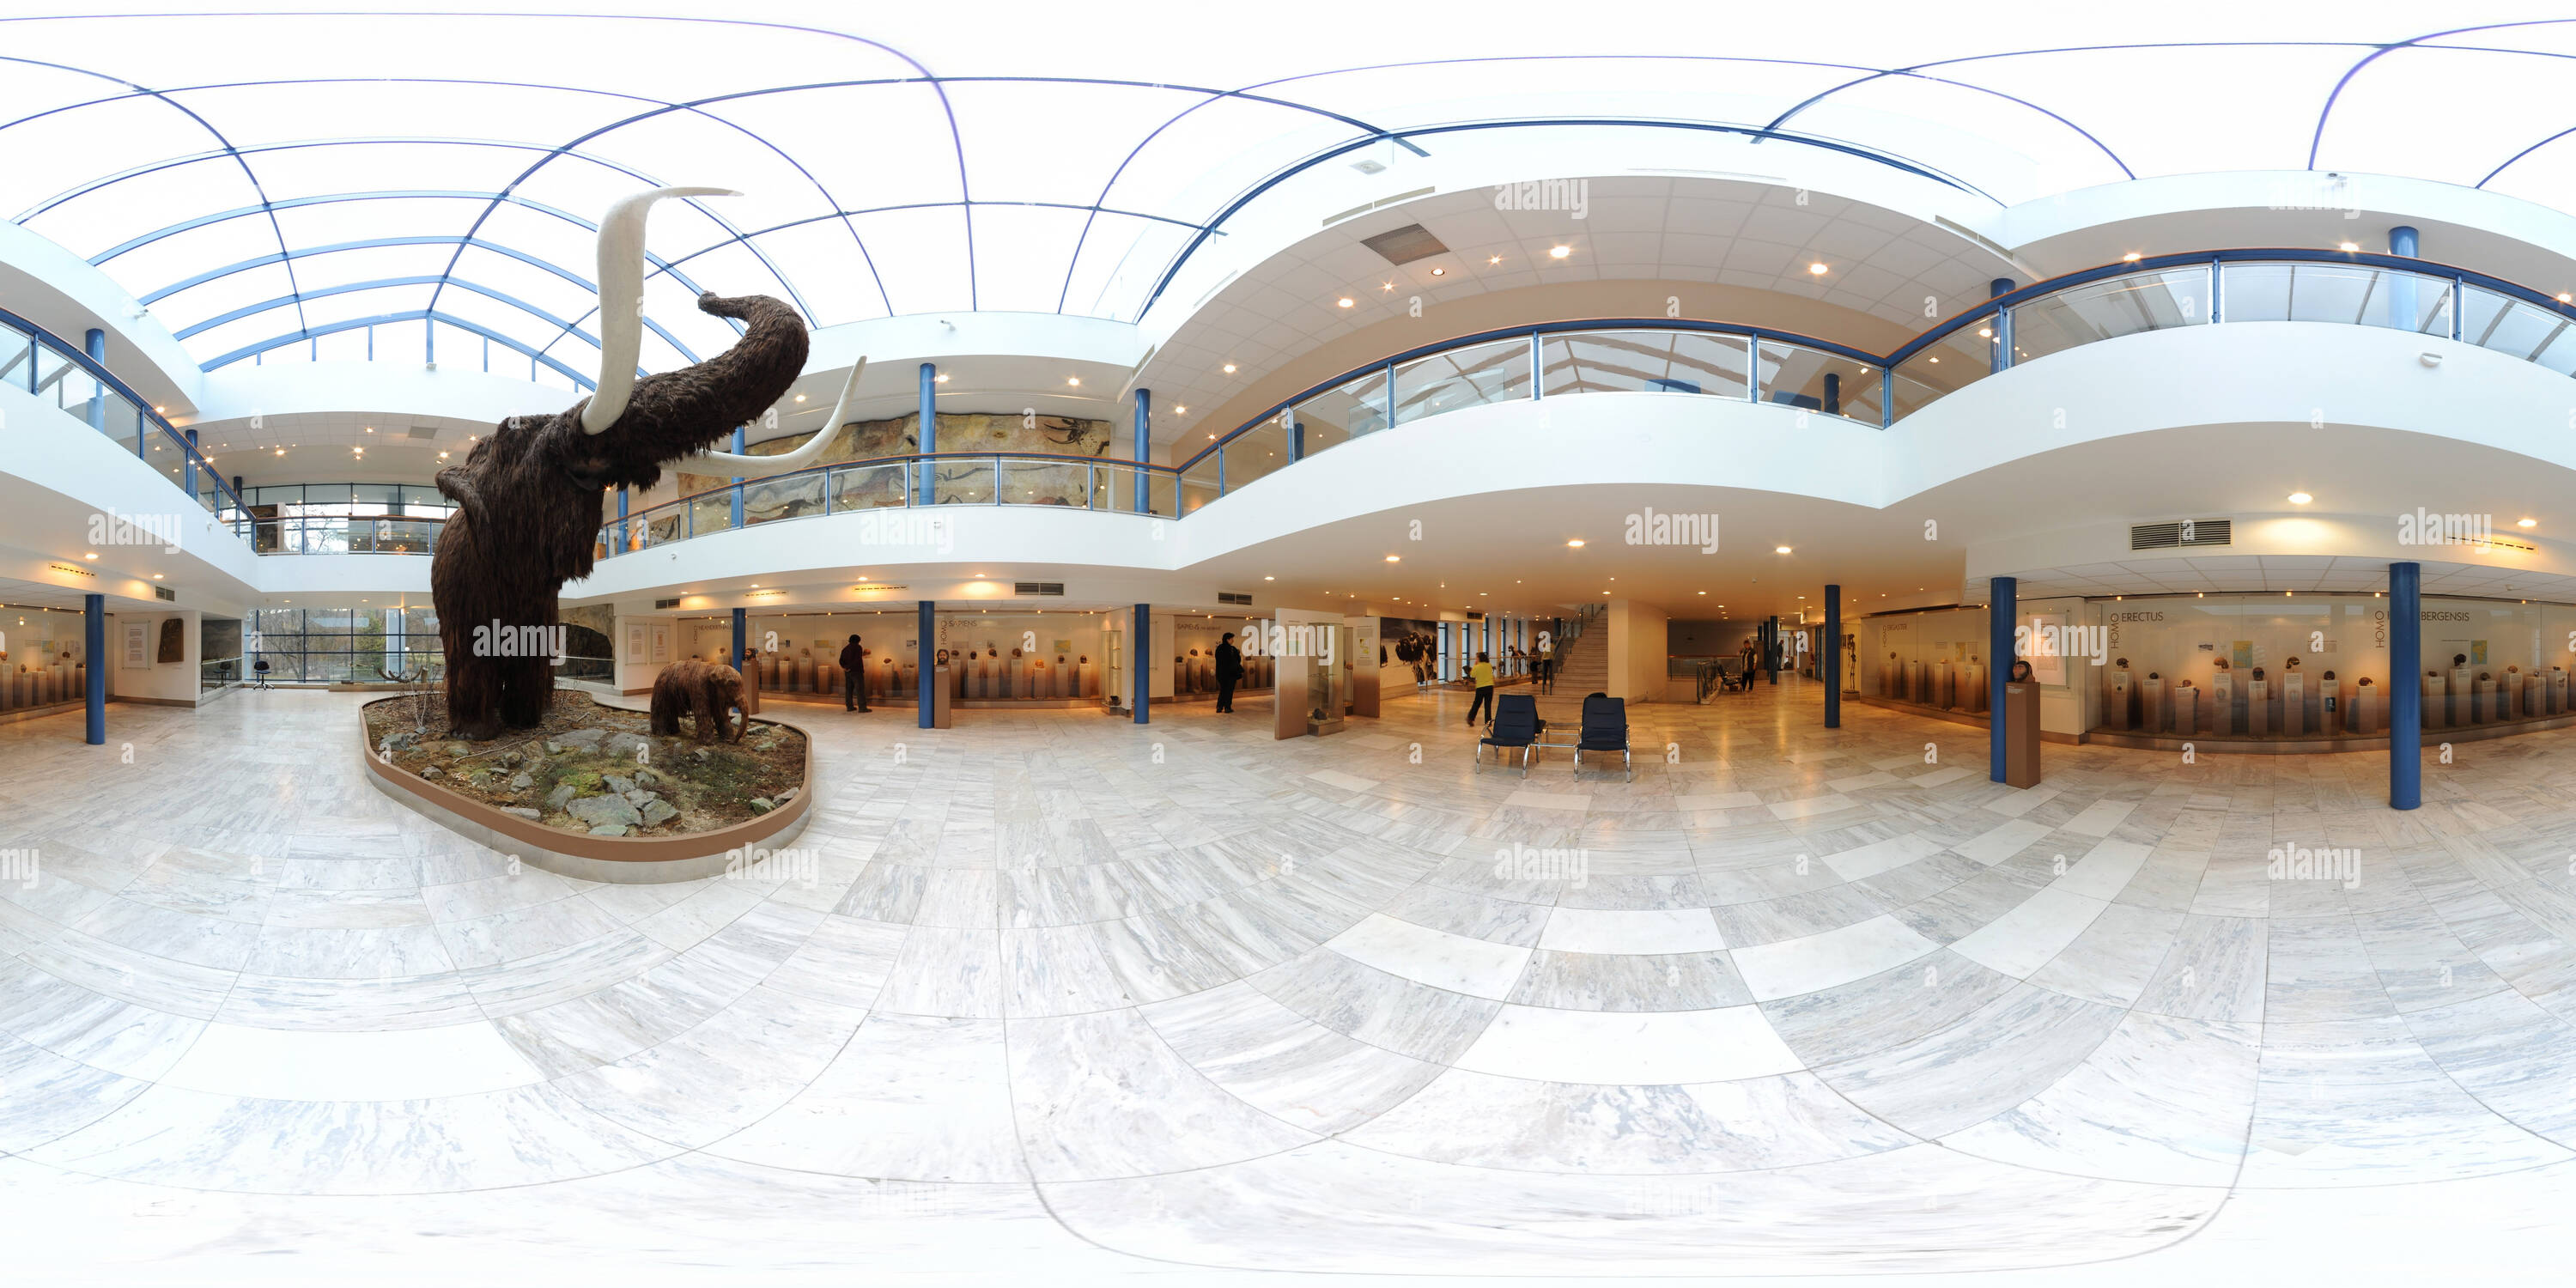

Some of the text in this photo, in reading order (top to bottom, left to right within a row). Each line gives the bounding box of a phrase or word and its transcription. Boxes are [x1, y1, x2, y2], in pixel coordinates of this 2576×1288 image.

[2111, 613, 2119, 649] HOMO
[2121, 611, 2164, 623] ERECTUS
[2375, 611, 2385, 648] HOMO
